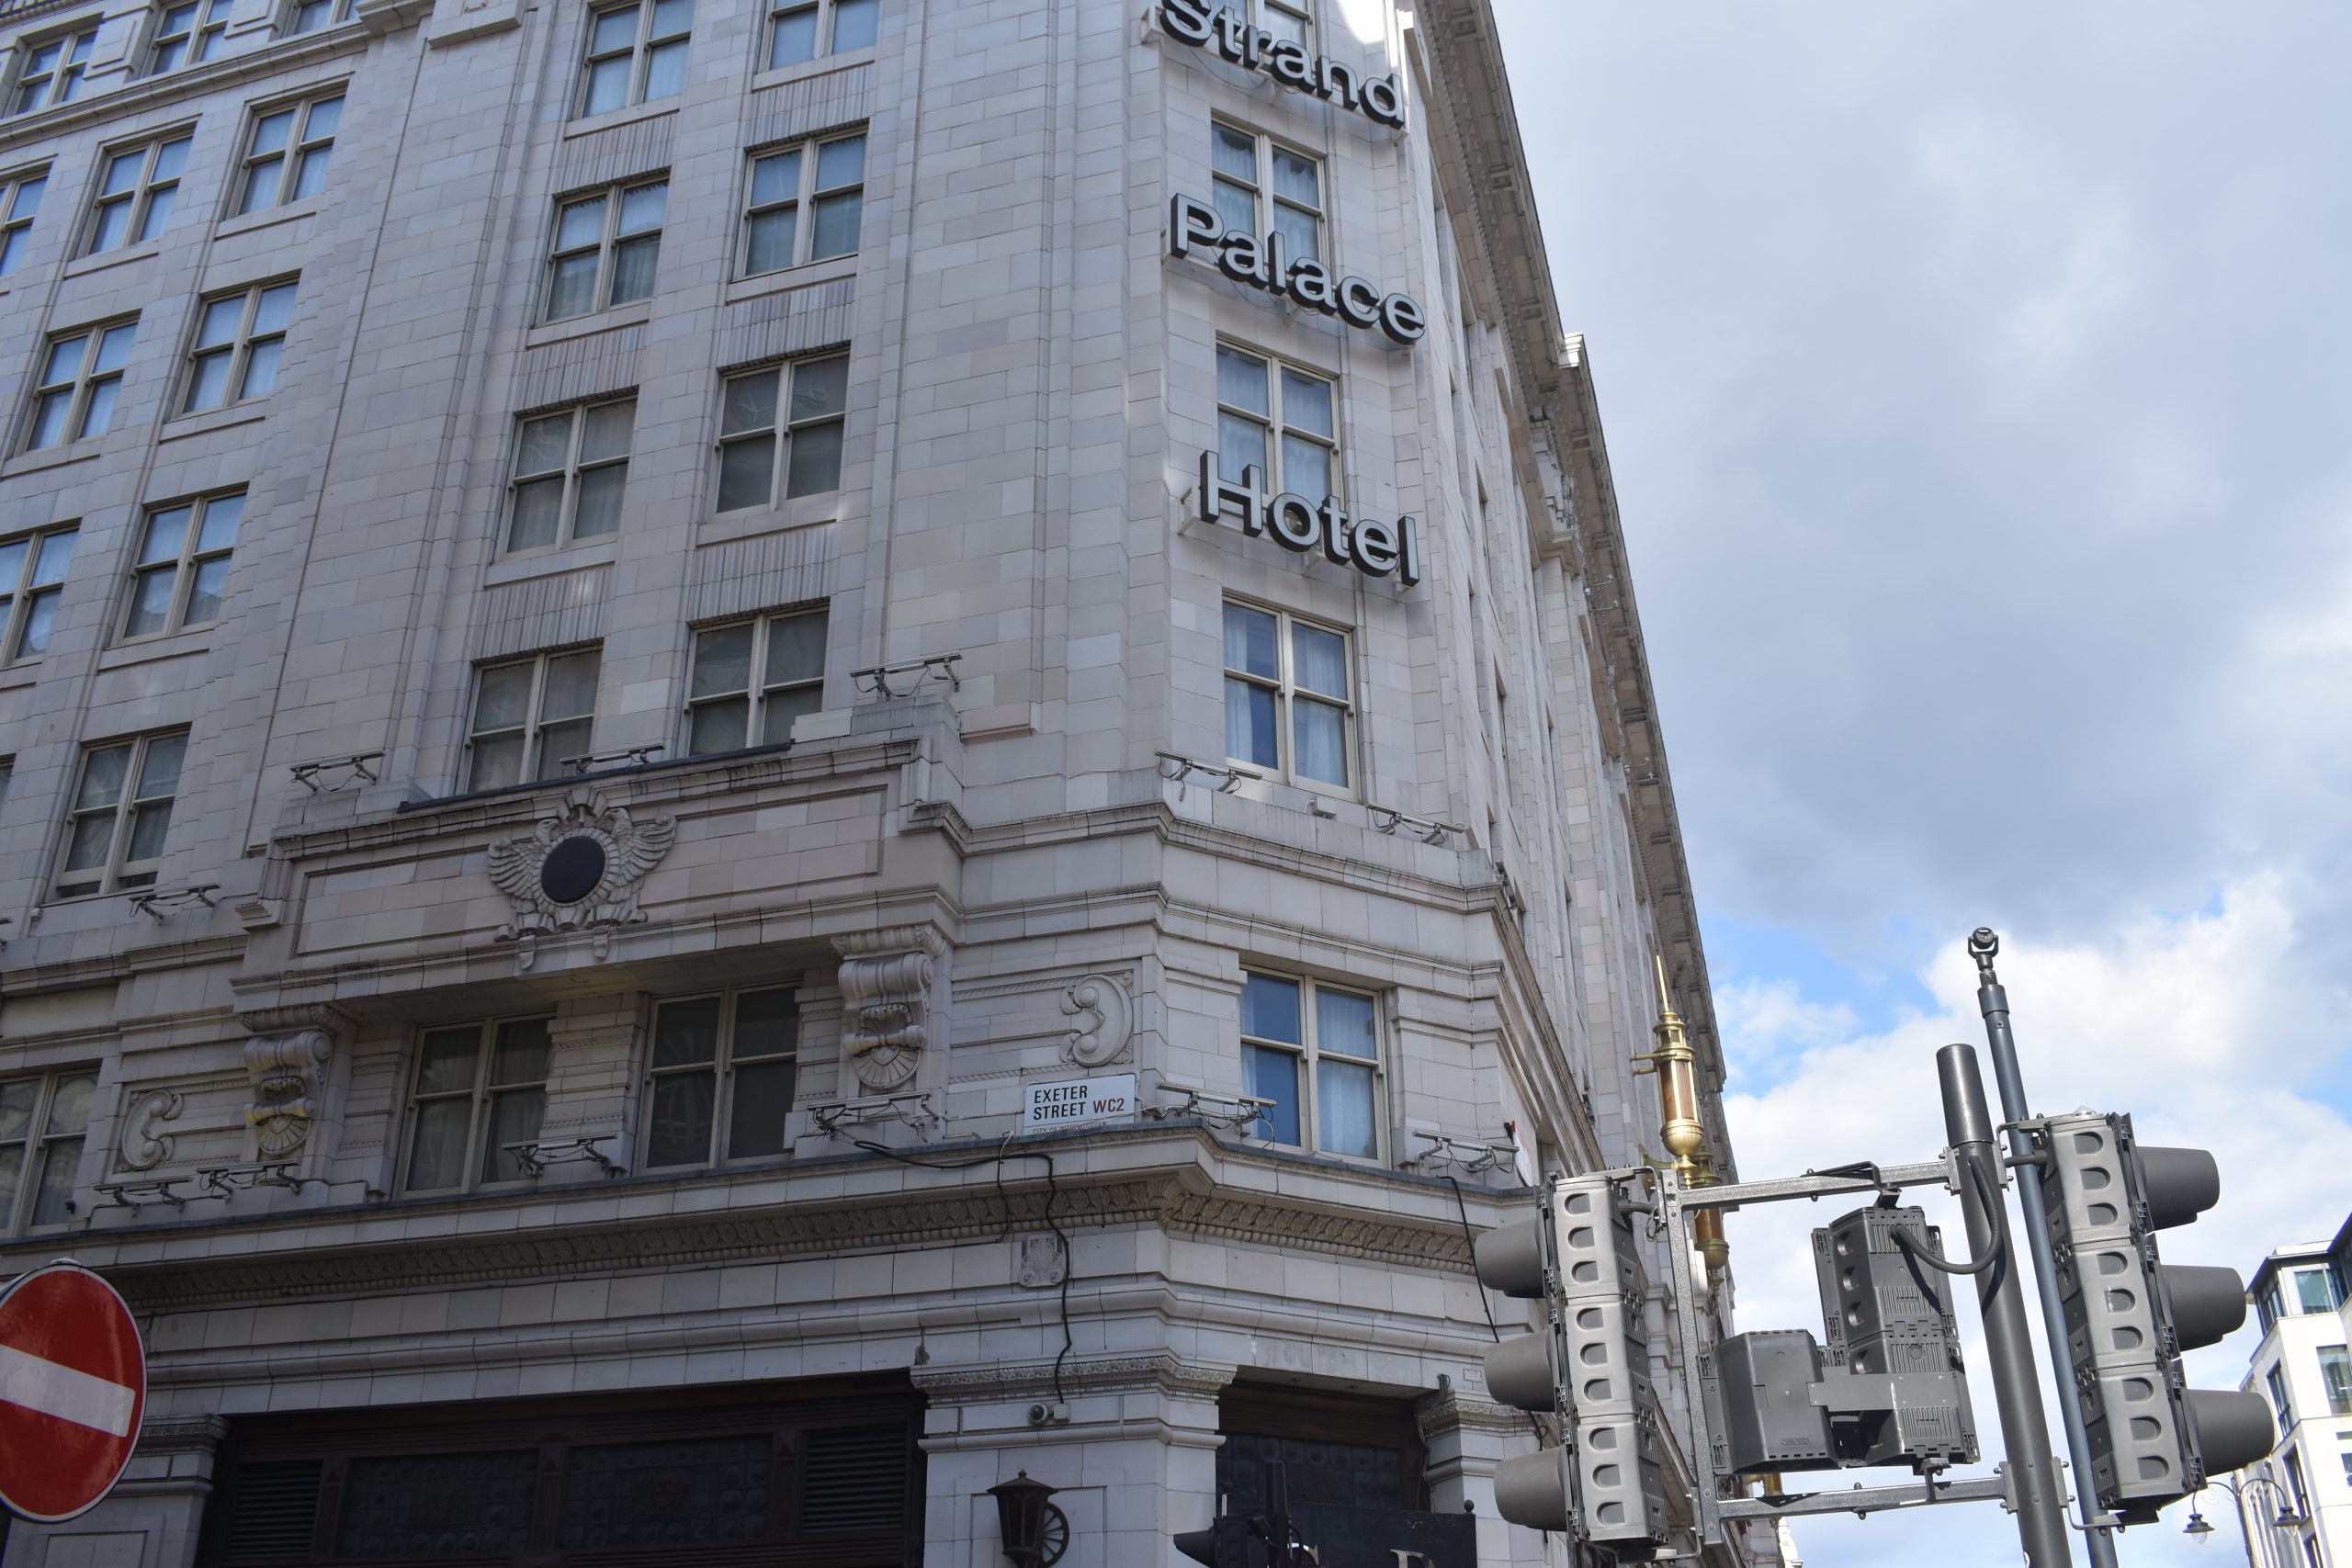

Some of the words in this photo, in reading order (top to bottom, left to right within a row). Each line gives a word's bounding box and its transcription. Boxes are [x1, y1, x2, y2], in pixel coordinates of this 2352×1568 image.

[1159, 0, 1406, 130] Strand
[1170, 192, 1426, 345] Palace
[1200, 449, 1419, 587] Hotel
[1033, 1102, 1086, 1120] STREET
[1092, 1098, 1125, 1114] WC2
[1035, 1085, 1088, 1103] EXETER
